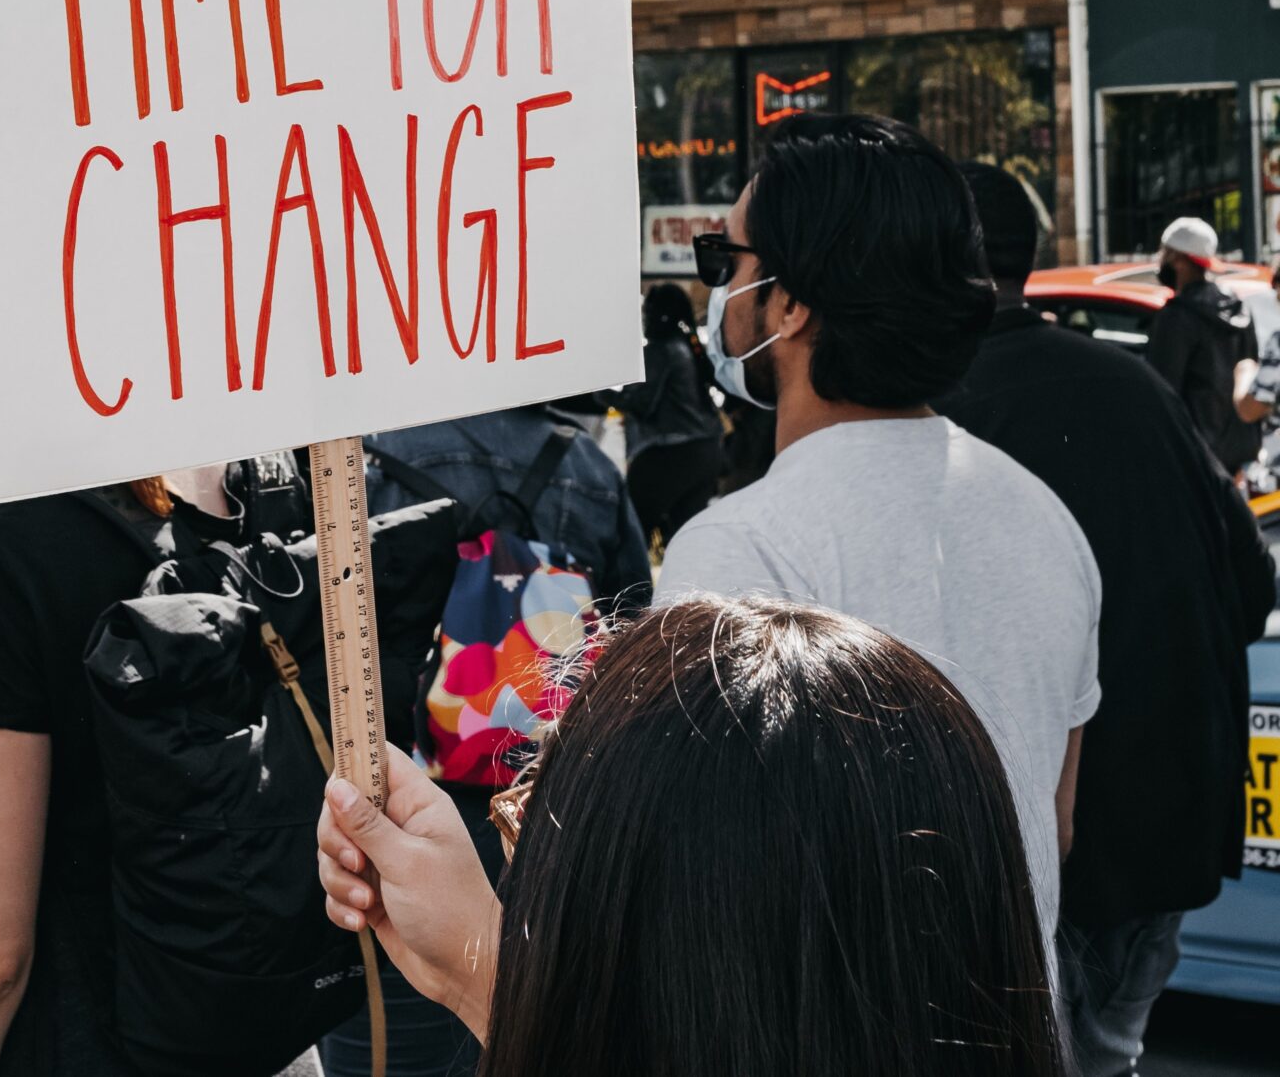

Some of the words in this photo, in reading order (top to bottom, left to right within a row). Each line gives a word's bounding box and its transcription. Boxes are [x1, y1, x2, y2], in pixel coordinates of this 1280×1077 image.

[62, 90, 573, 417] CHANGE
[346, 454, 355, 467] 10
[348, 476, 356, 488] 11
[350, 498, 358, 511] 12
[351, 519, 360, 532] 13
[353, 540, 361, 553] 14
[355, 562, 363, 575] 15
[356, 583, 365, 596] 16
[358, 604, 367, 616] 17
[360, 625, 368, 638] 18
[361, 647, 370, 659] 19
[363, 667, 372, 681] 20
[365, 688, 373, 701] 21
[367, 709, 375, 723] 22
[368, 731, 377, 744] 23
[370, 751, 378, 765] 24
[372, 773, 380, 787] 25
[373, 793, 382, 808] 26
